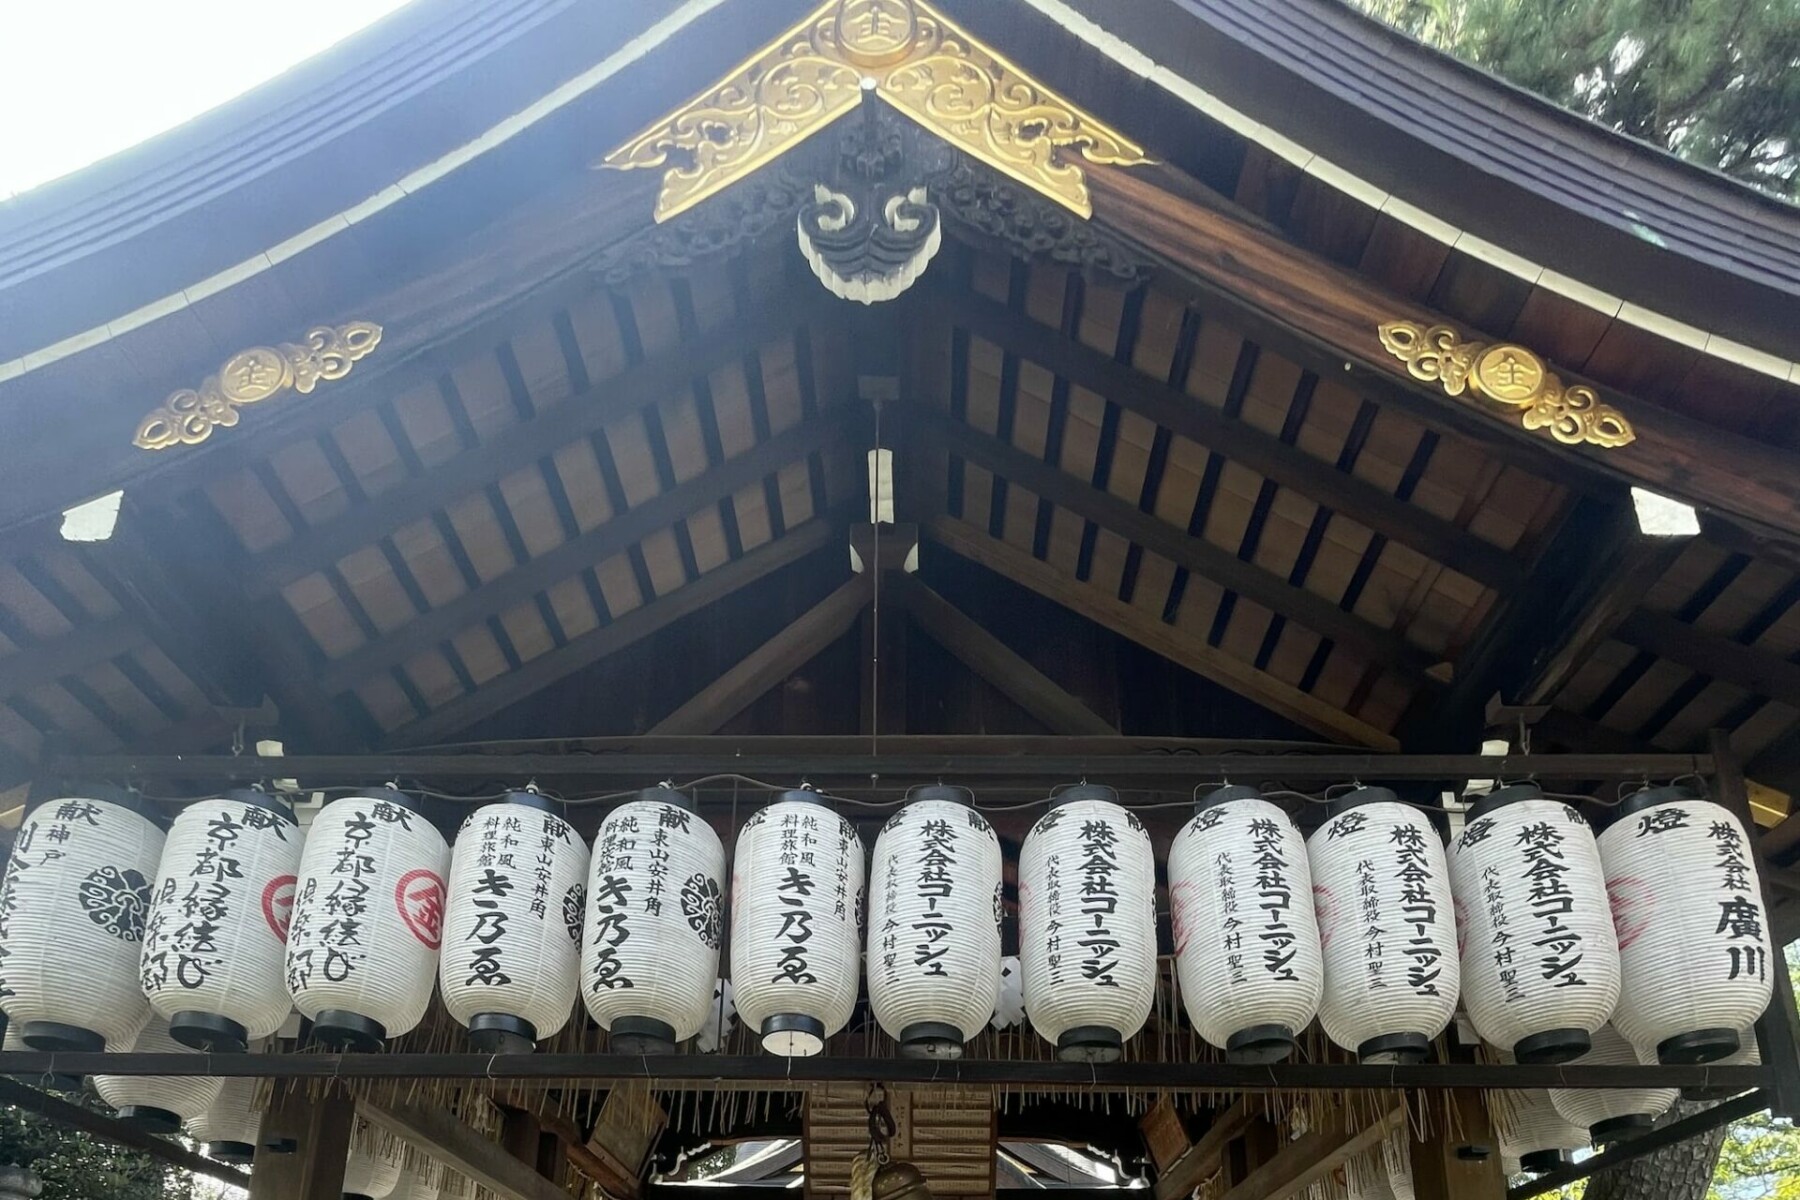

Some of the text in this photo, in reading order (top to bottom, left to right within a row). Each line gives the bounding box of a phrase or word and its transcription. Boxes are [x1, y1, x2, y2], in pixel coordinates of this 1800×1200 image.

[55, 801, 103, 826] 献
[241, 806, 289, 842] 献
[371, 801, 412, 831] 献
[476, 815, 500, 868] 料理旅館
[543, 813, 572, 846] 献
[658, 804, 691, 835] 献
[779, 814, 800, 866] 料理旅館
[800, 816, 819, 868] 純和風
[1636, 807, 1692, 839] 燈
[40, 824, 71, 866] 神戸
[497, 816, 523, 870] 純和風
[597, 818, 619, 878] 料理旅館
[614, 816, 640, 872] 純和風
[171, 811, 245, 989] 京都縁結び
[319, 811, 376, 982] 京都縁結び
[528, 836, 556, 920] 東山安井角
[644, 828, 671, 917] 東山安井角
[833, 837, 859, 921] 東山安井角
[911, 818, 960, 977] 株式会社コーニッシュ
[1247, 818, 1301, 983] 株式会社コーニッシュ
[1076, 818, 1122, 988] 株式会社コーニッシュ
[1388, 822, 1443, 998] 株式会社コーニッシュ
[1513, 821, 1588, 989] 株式会社コーニッシュ
[1706, 819, 1767, 985] 株式会社 廣川
